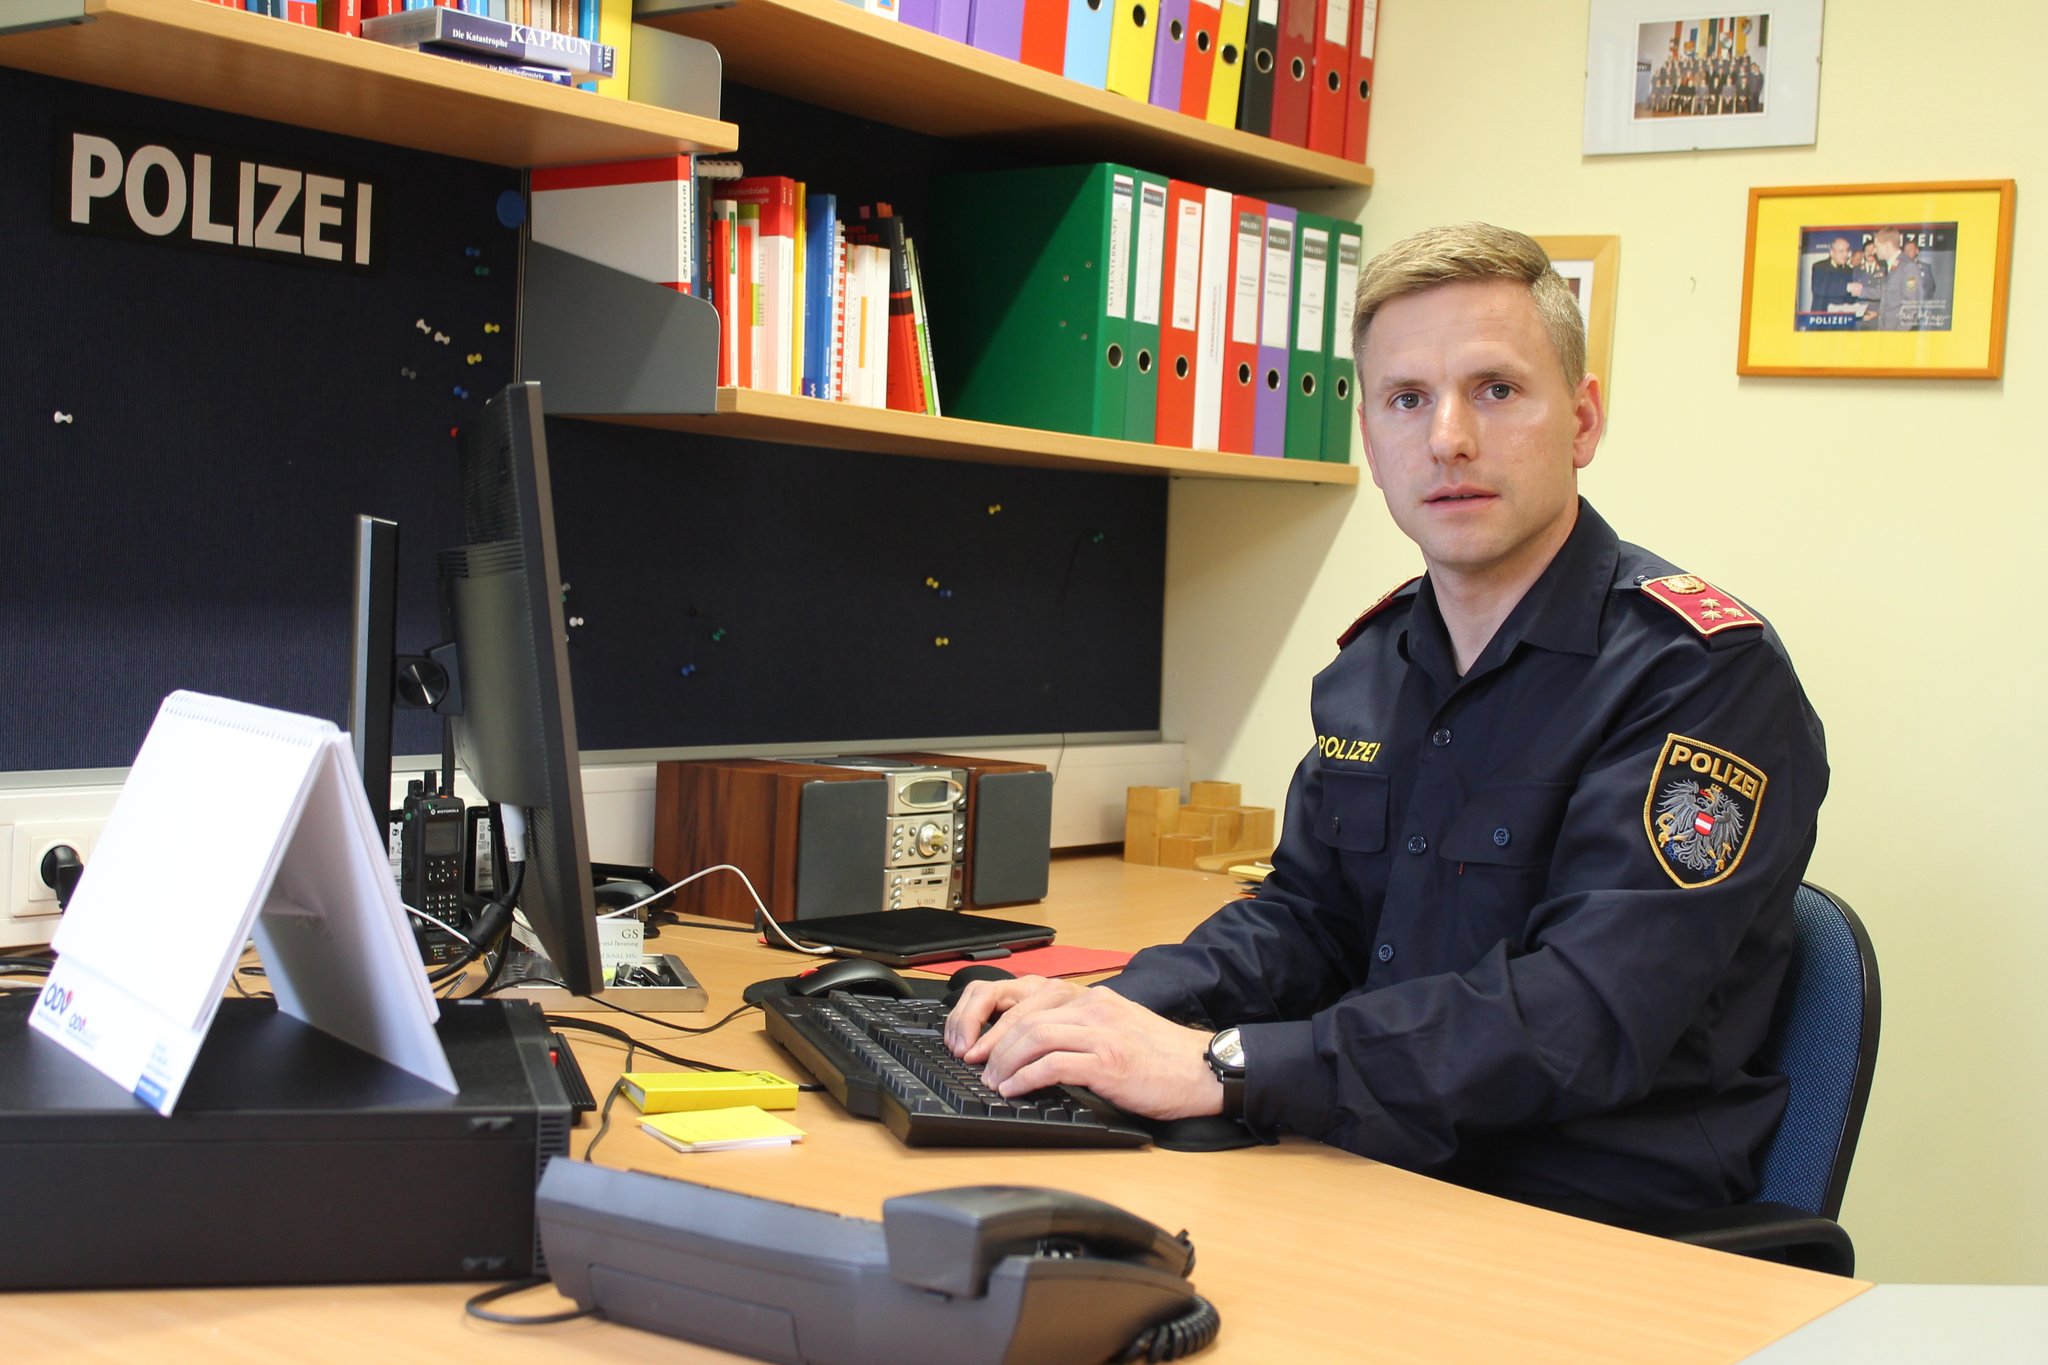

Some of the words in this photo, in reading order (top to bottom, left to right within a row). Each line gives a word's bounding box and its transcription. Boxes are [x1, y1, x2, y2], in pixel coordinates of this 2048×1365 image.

[452, 28, 465, 40] Die
[466, 31, 509, 48] Katastrophe
[510, 23, 591, 56] KAPRUN
[603, 45, 612, 69] VHS
[71, 132, 373, 266] POLIZEI
[1240, 220, 1260, 231] POLIZEI
[1269, 235, 1288, 246] POLIZEI
[1862, 233, 1934, 248] PIZEI
[1809, 316, 1848, 325] POLIZEI
[1318, 735, 1381, 763] POLIZEI
[1669, 744, 1760, 800] POLIZEI
[621, 928, 639, 940] GS
